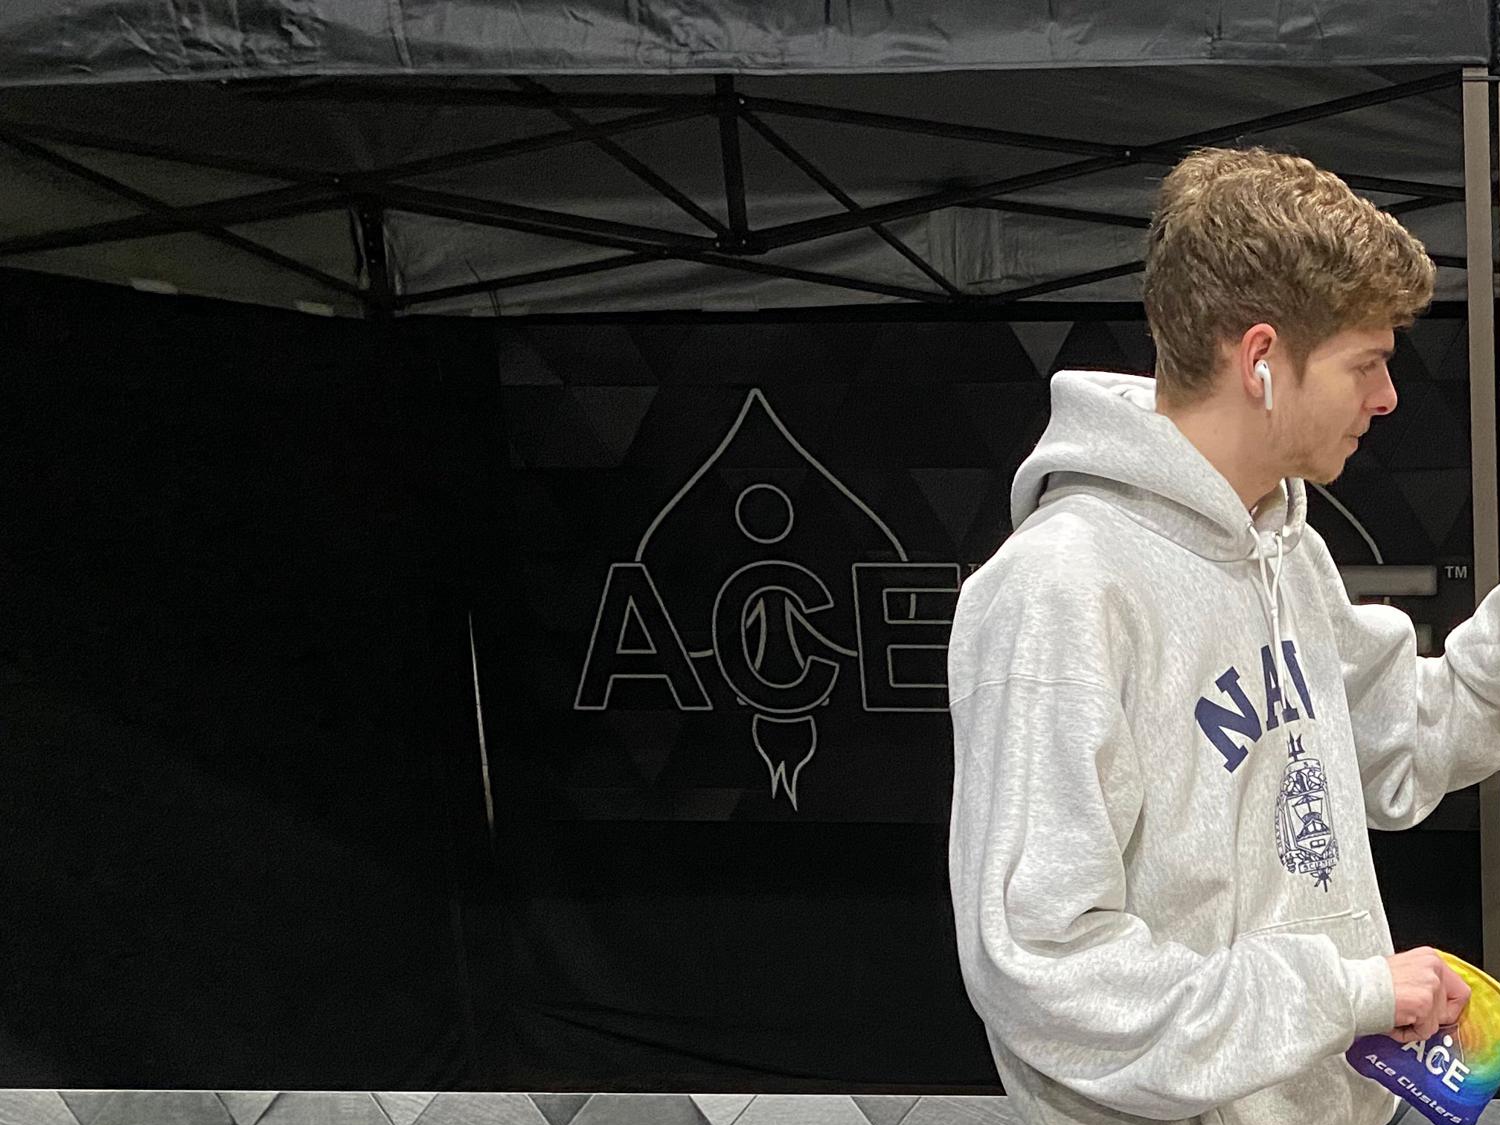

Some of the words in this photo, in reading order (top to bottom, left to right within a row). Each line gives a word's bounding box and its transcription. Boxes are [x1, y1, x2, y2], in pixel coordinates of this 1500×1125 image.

[1445, 566, 1468, 579] TM
[574, 560, 960, 712] ACE
[1365, 1054, 1396, 1076] Ace
[1397, 1076, 1462, 1124] Clusters
[1401, 1040, 1471, 1093] ACE
